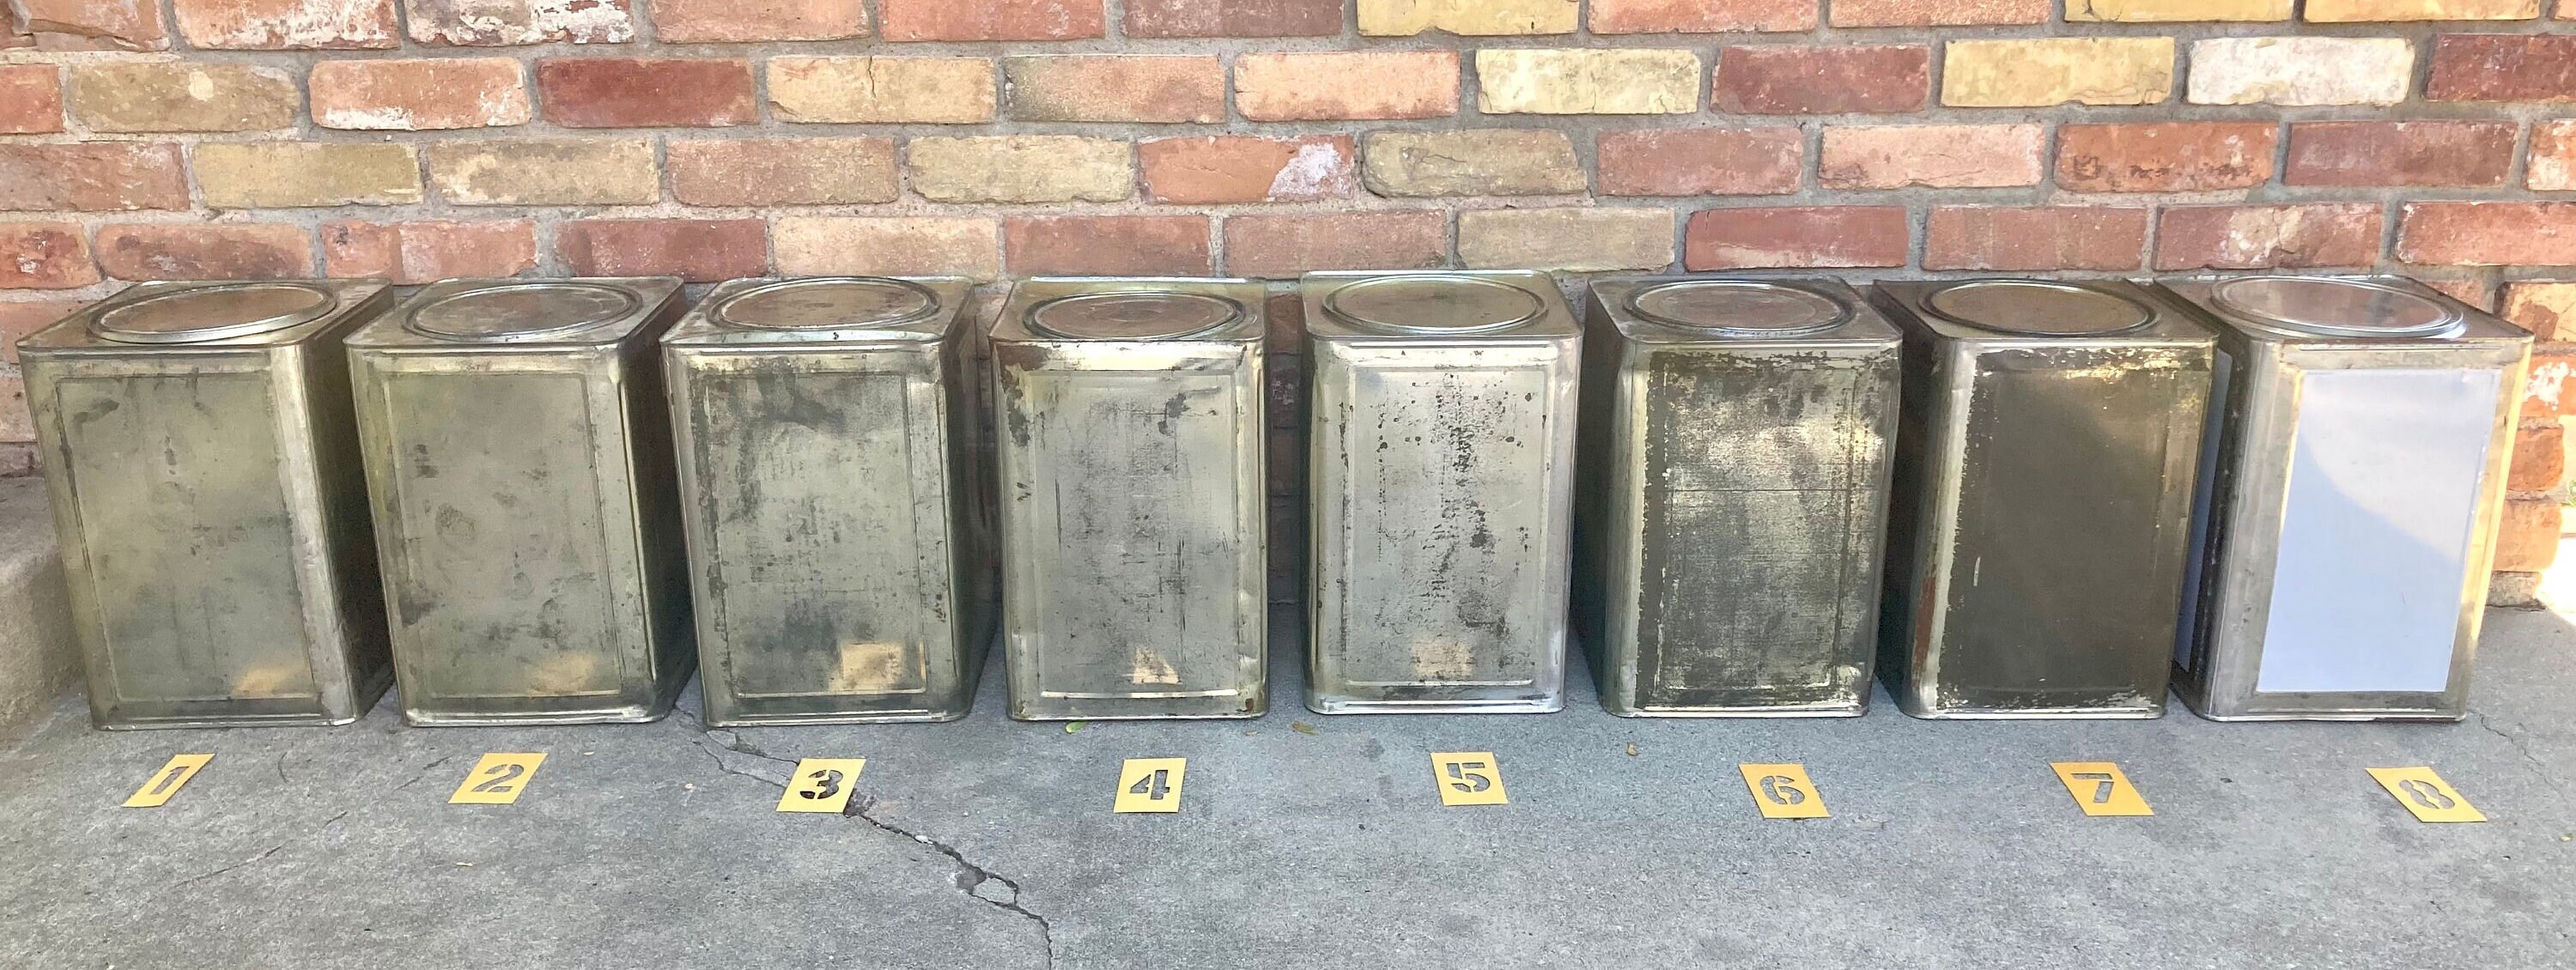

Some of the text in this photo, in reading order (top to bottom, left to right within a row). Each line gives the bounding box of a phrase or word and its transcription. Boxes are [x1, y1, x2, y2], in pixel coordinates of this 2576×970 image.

[150, 766, 190, 795] 1
[471, 764, 526, 793] 2
[799, 770, 844, 800] 3
[1129, 769, 1170, 800] 4
[1446, 761, 1492, 792] 5
[1759, 775, 1804, 805] 6
[2071, 773, 2113, 803] 7
[2399, 779, 2455, 809] 8
